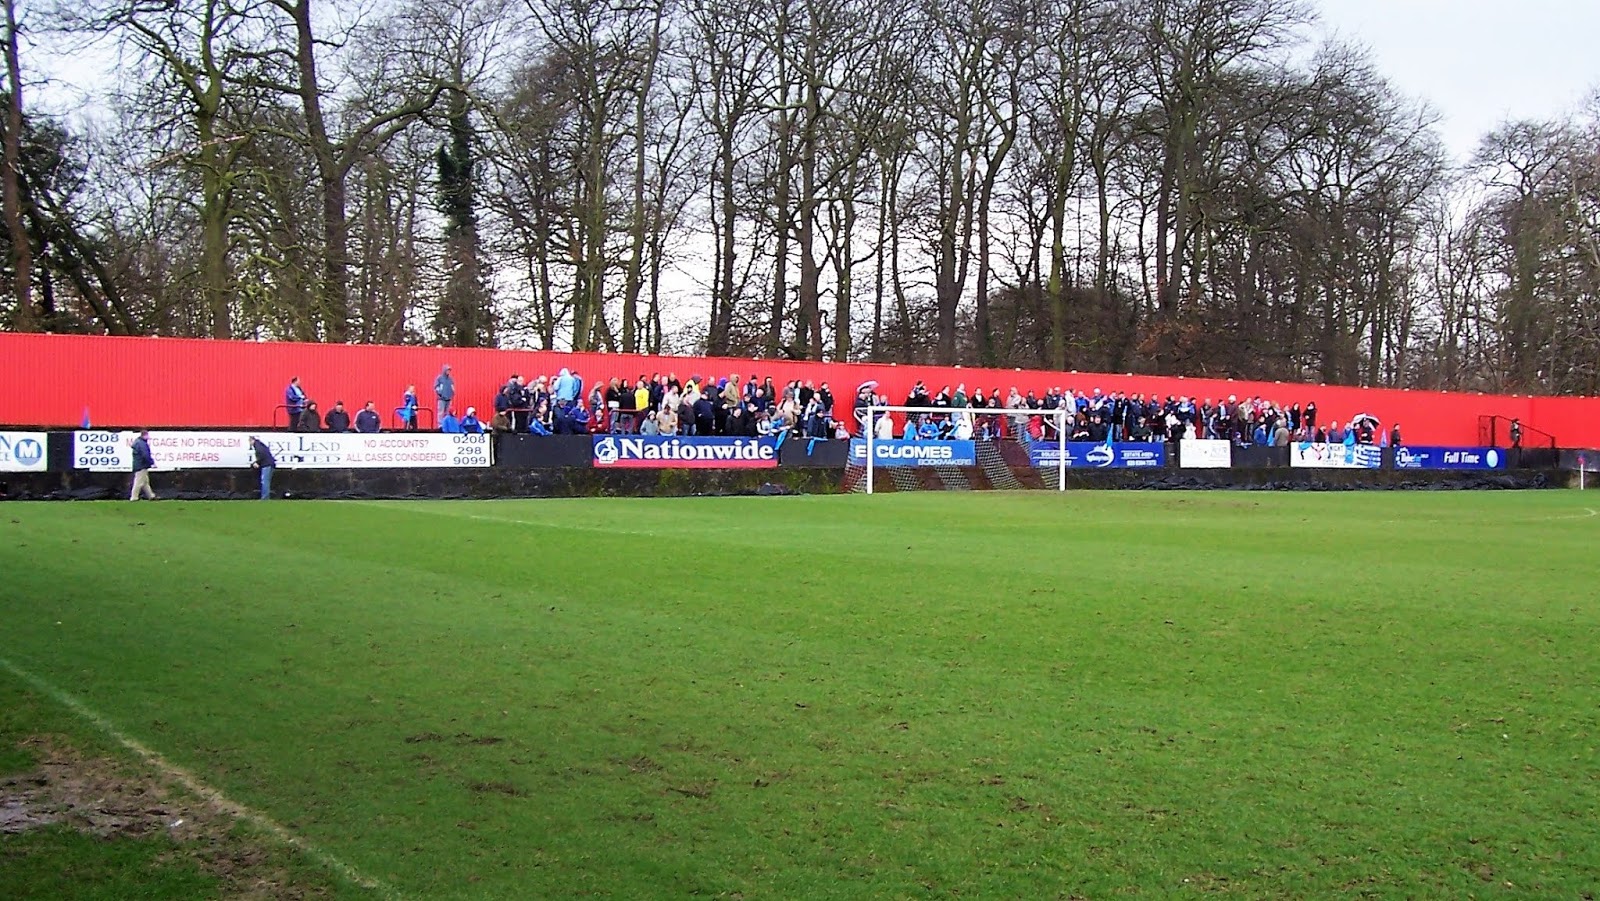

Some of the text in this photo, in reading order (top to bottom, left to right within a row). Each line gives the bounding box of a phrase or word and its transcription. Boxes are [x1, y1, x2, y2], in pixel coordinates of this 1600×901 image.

[79, 433, 119, 442] 0208
[452, 435, 486, 444] 0208
[126, 438, 241, 448] MTGAGE NO PROBLEM
[364, 439, 429, 448] NO ACCOUNTS?
[84, 446, 114, 455] 298
[457, 447, 482, 455] 298
[619, 438, 774, 460] Nationwide
[79, 456, 120, 466] 9099
[176, 453, 220, 462] ARREARS
[346, 453, 447, 462] ALL CASES CONSIDERED
[453, 456, 487, 465] 9099
[918, 458, 972, 466] BOOKMAKERS
[1444, 451, 1460, 464] Full
[1461, 451, 1480, 464] Time
